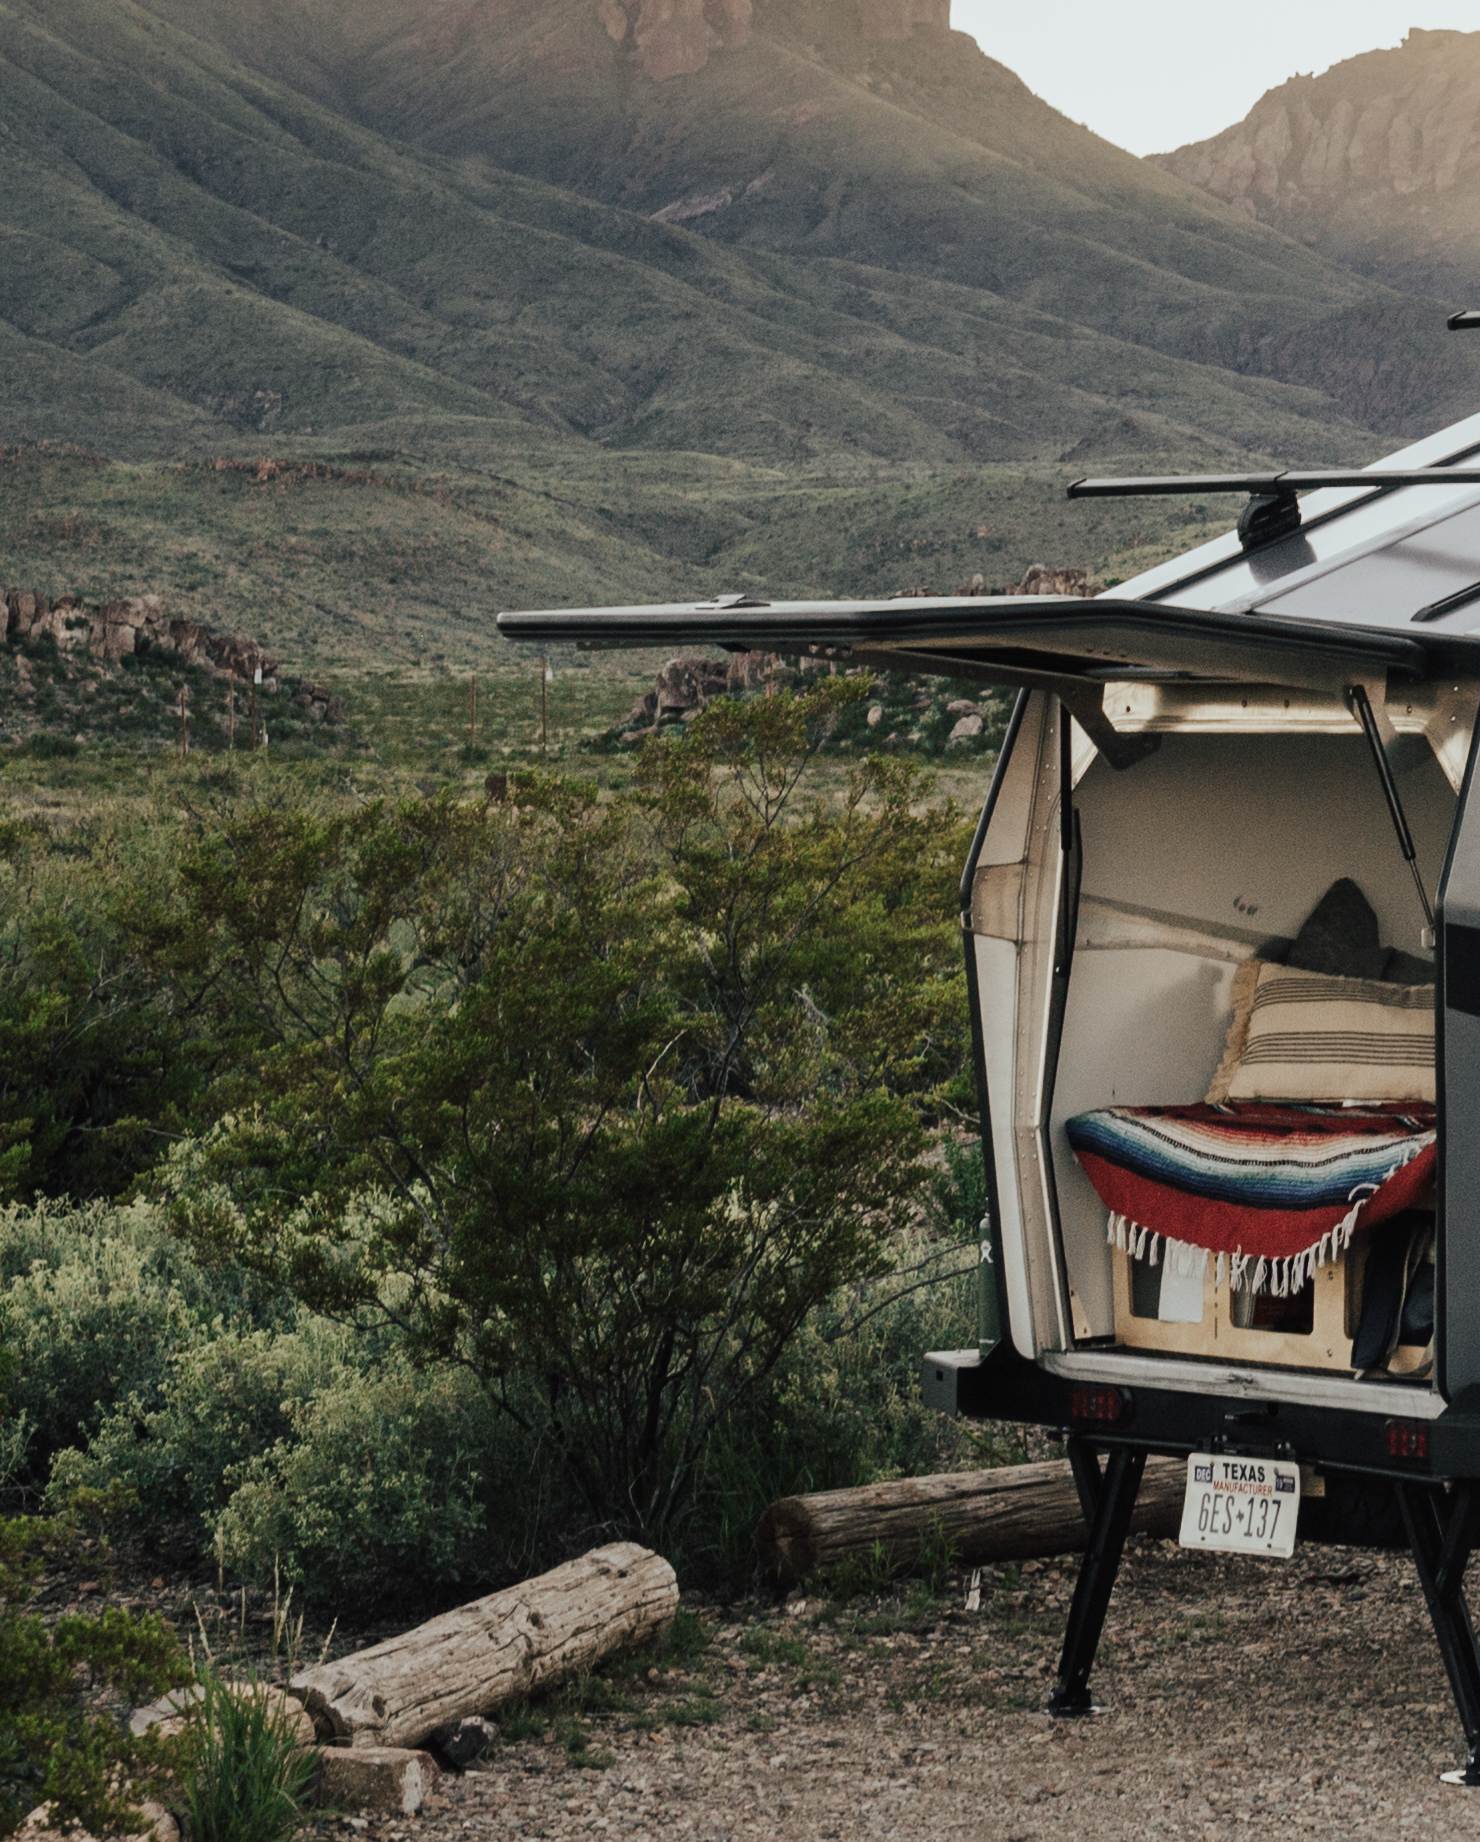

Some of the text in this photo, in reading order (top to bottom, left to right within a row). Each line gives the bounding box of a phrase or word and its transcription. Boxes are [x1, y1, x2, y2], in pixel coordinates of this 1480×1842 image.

[1196, 1466, 1211, 1481] DEC
[1223, 1462, 1266, 1483] TEXAS
[1213, 1480, 1273, 1497] MANUFACTURER
